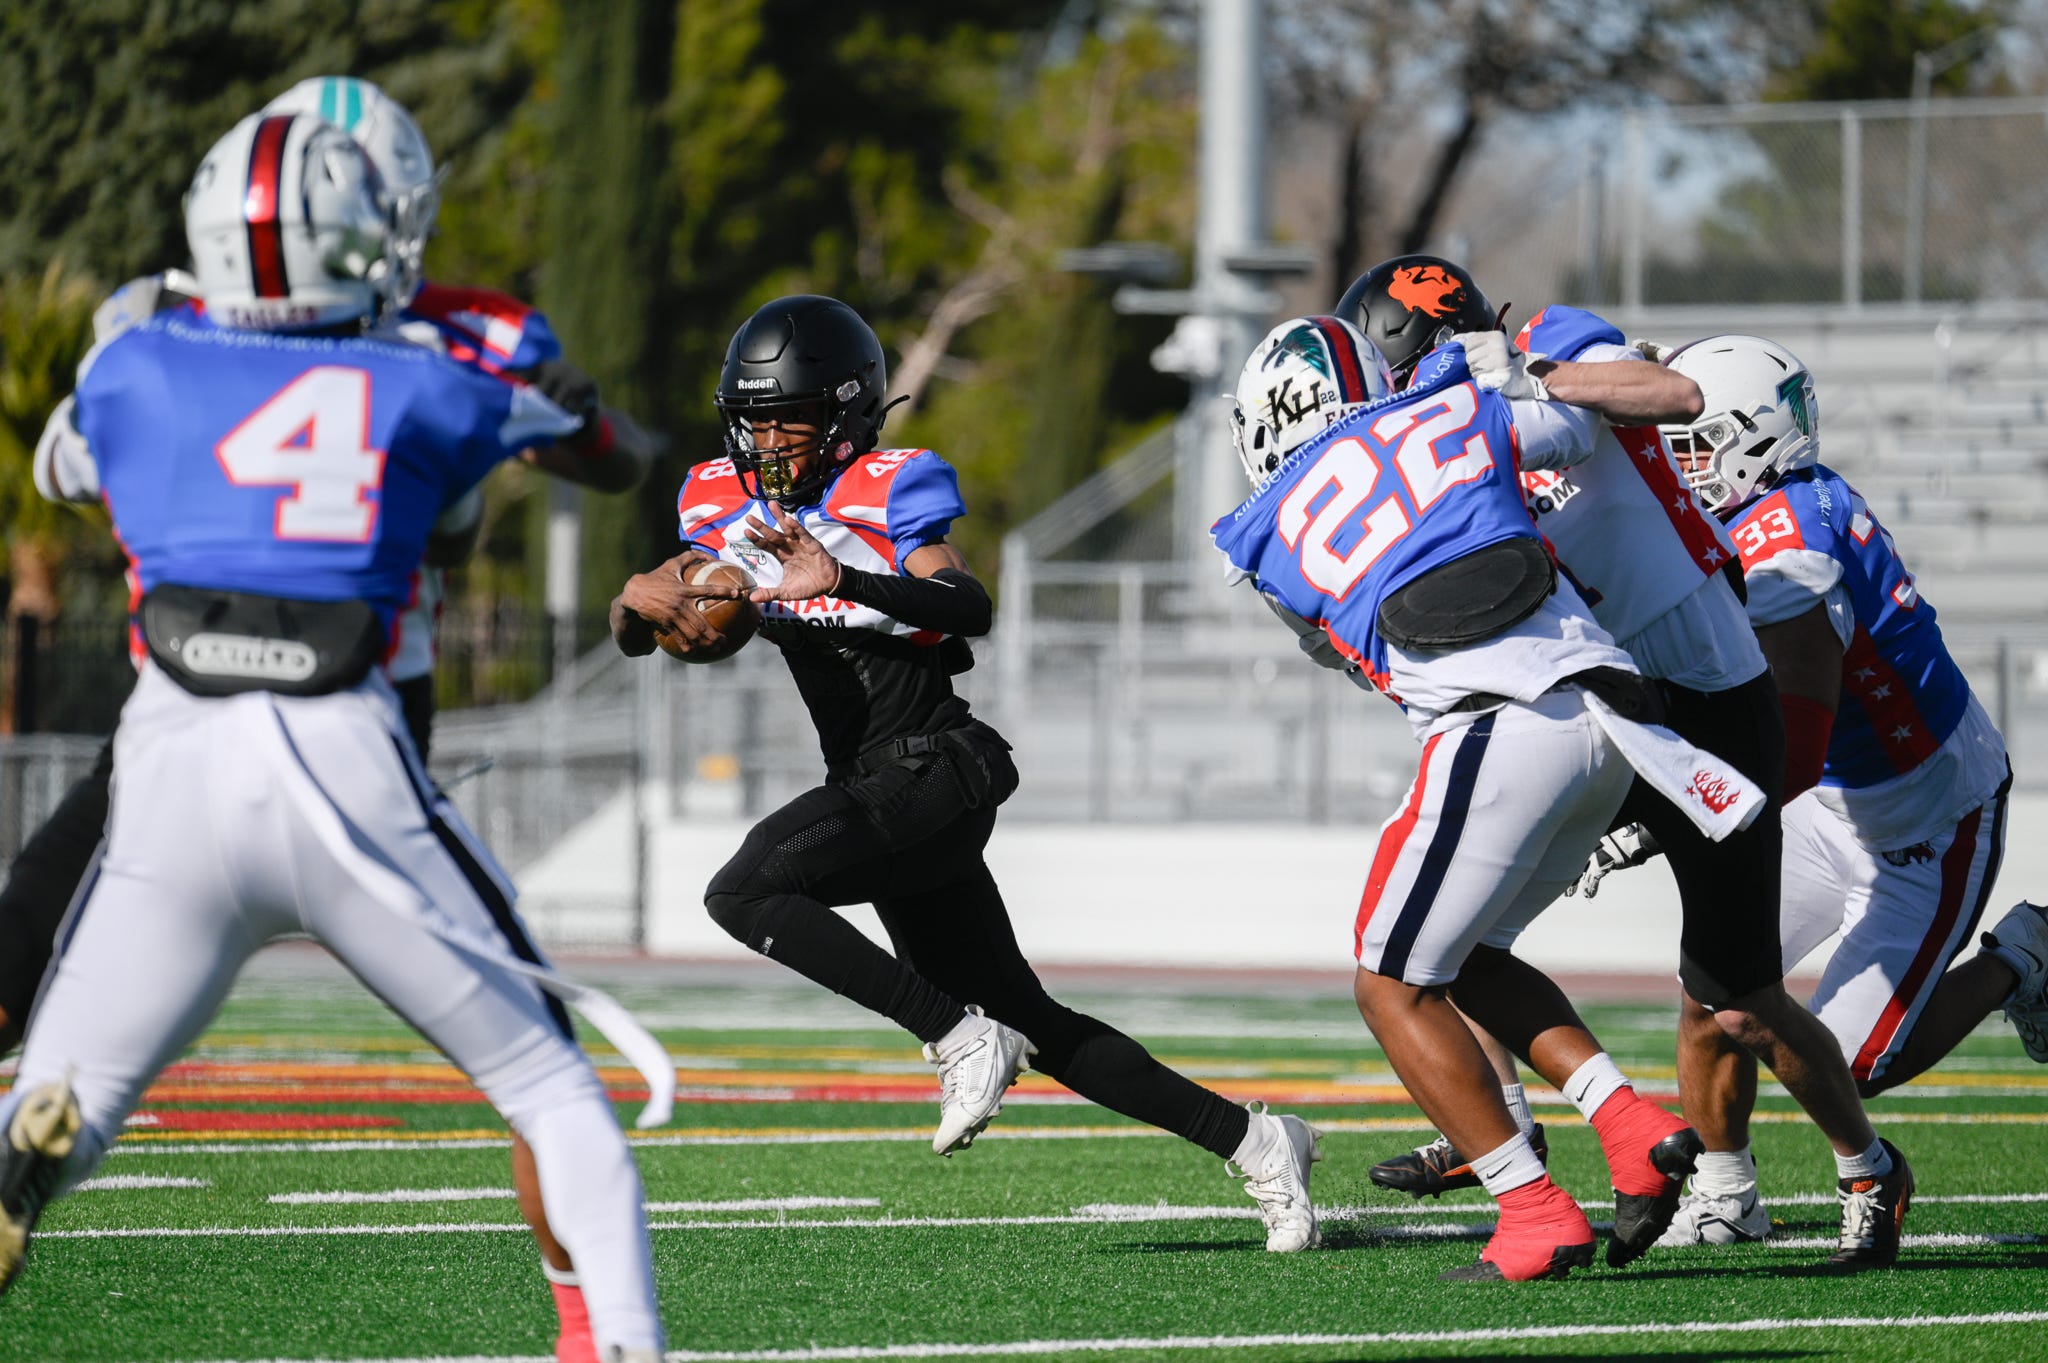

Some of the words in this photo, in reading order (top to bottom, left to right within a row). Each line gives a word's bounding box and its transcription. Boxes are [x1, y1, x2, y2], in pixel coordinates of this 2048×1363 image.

[738, 379, 773, 390] Riddell
[1320, 390, 1337, 405] 22
[215, 366, 387, 543] 4
[865, 449, 918, 478] 48
[1278, 381, 1496, 604] 22
[1735, 507, 1795, 557] 33
